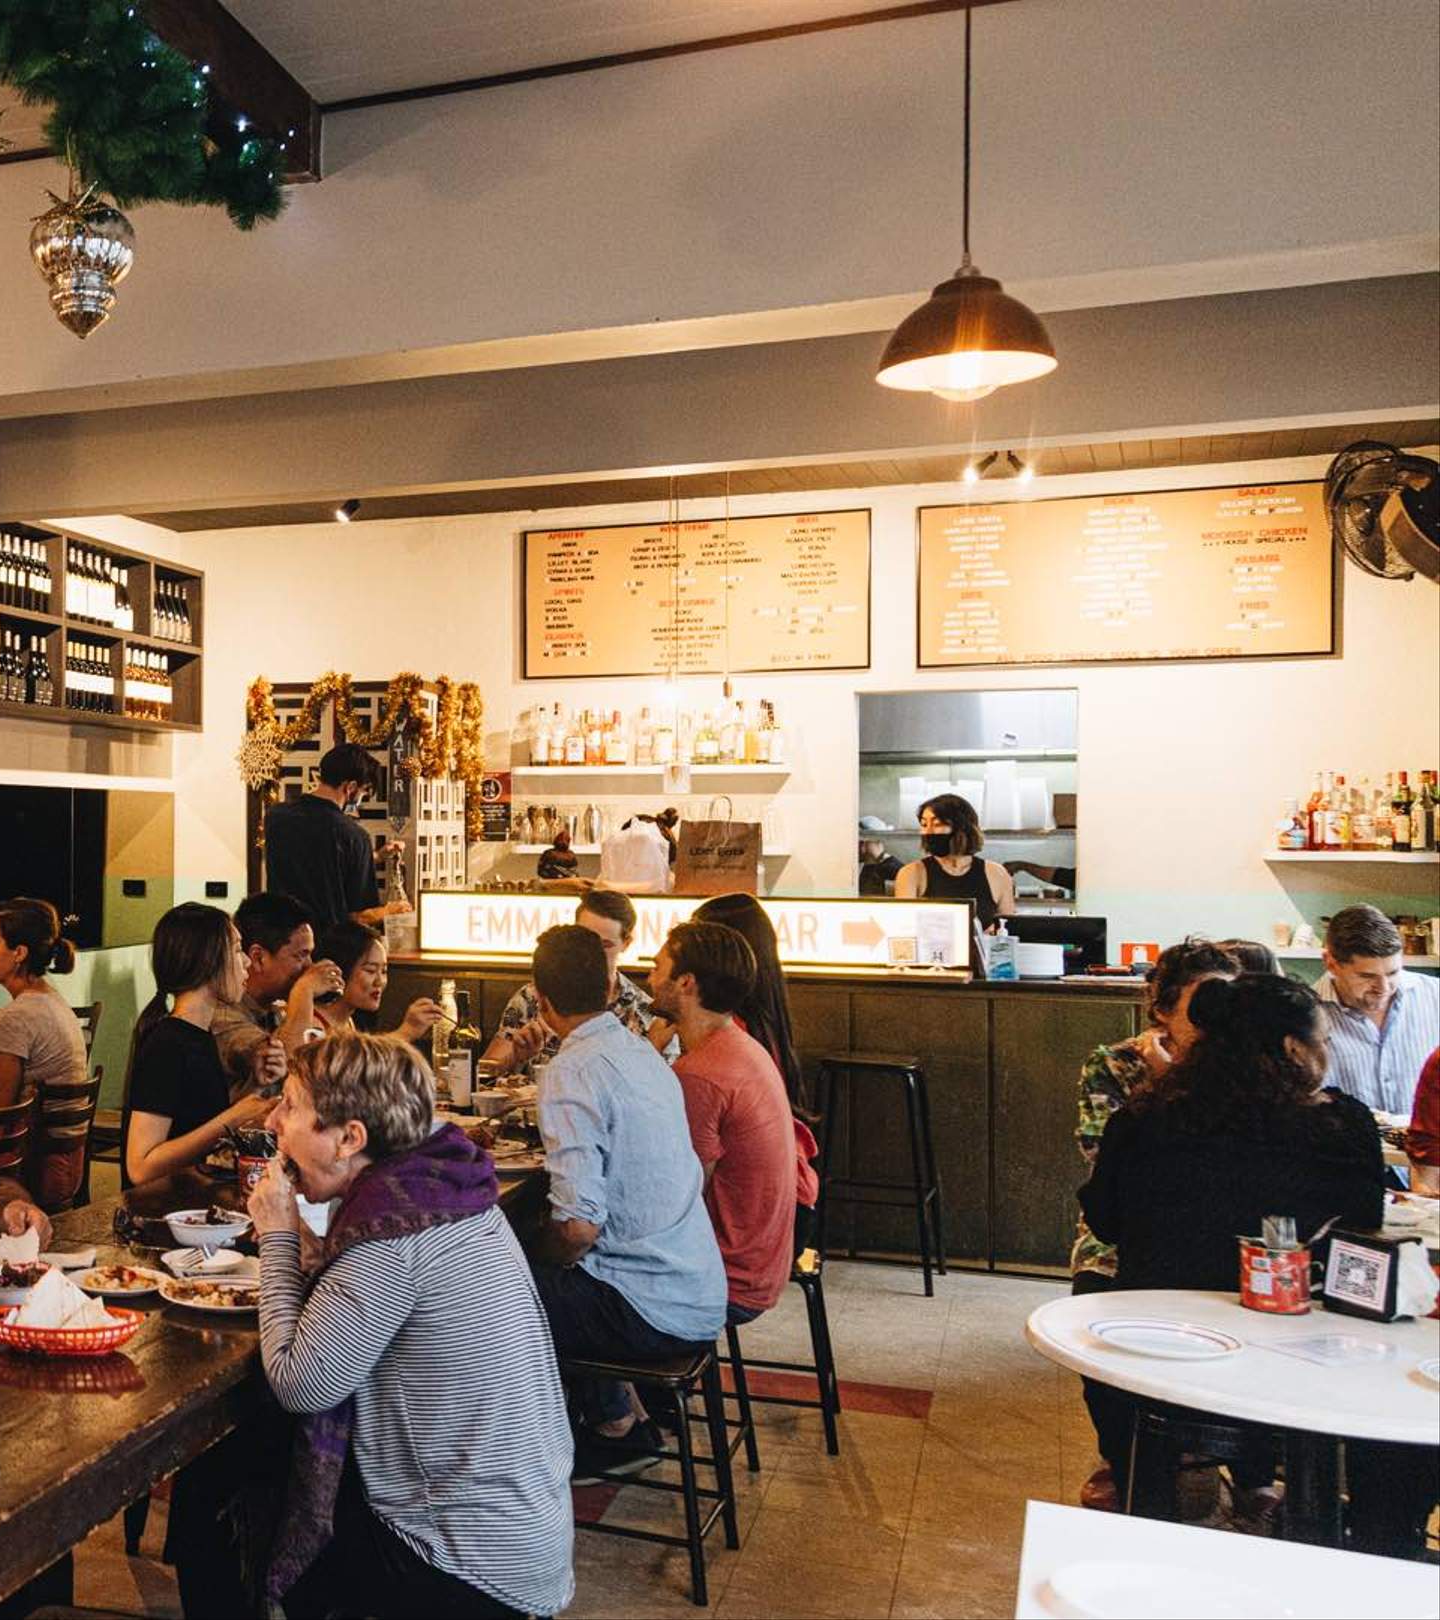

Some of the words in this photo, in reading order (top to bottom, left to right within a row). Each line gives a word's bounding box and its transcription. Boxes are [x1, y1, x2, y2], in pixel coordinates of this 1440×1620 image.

[1259, 527, 1309, 537] CHICKEN
[393, 718, 404, 793] WATER
[775, 911, 819, 952] AR
